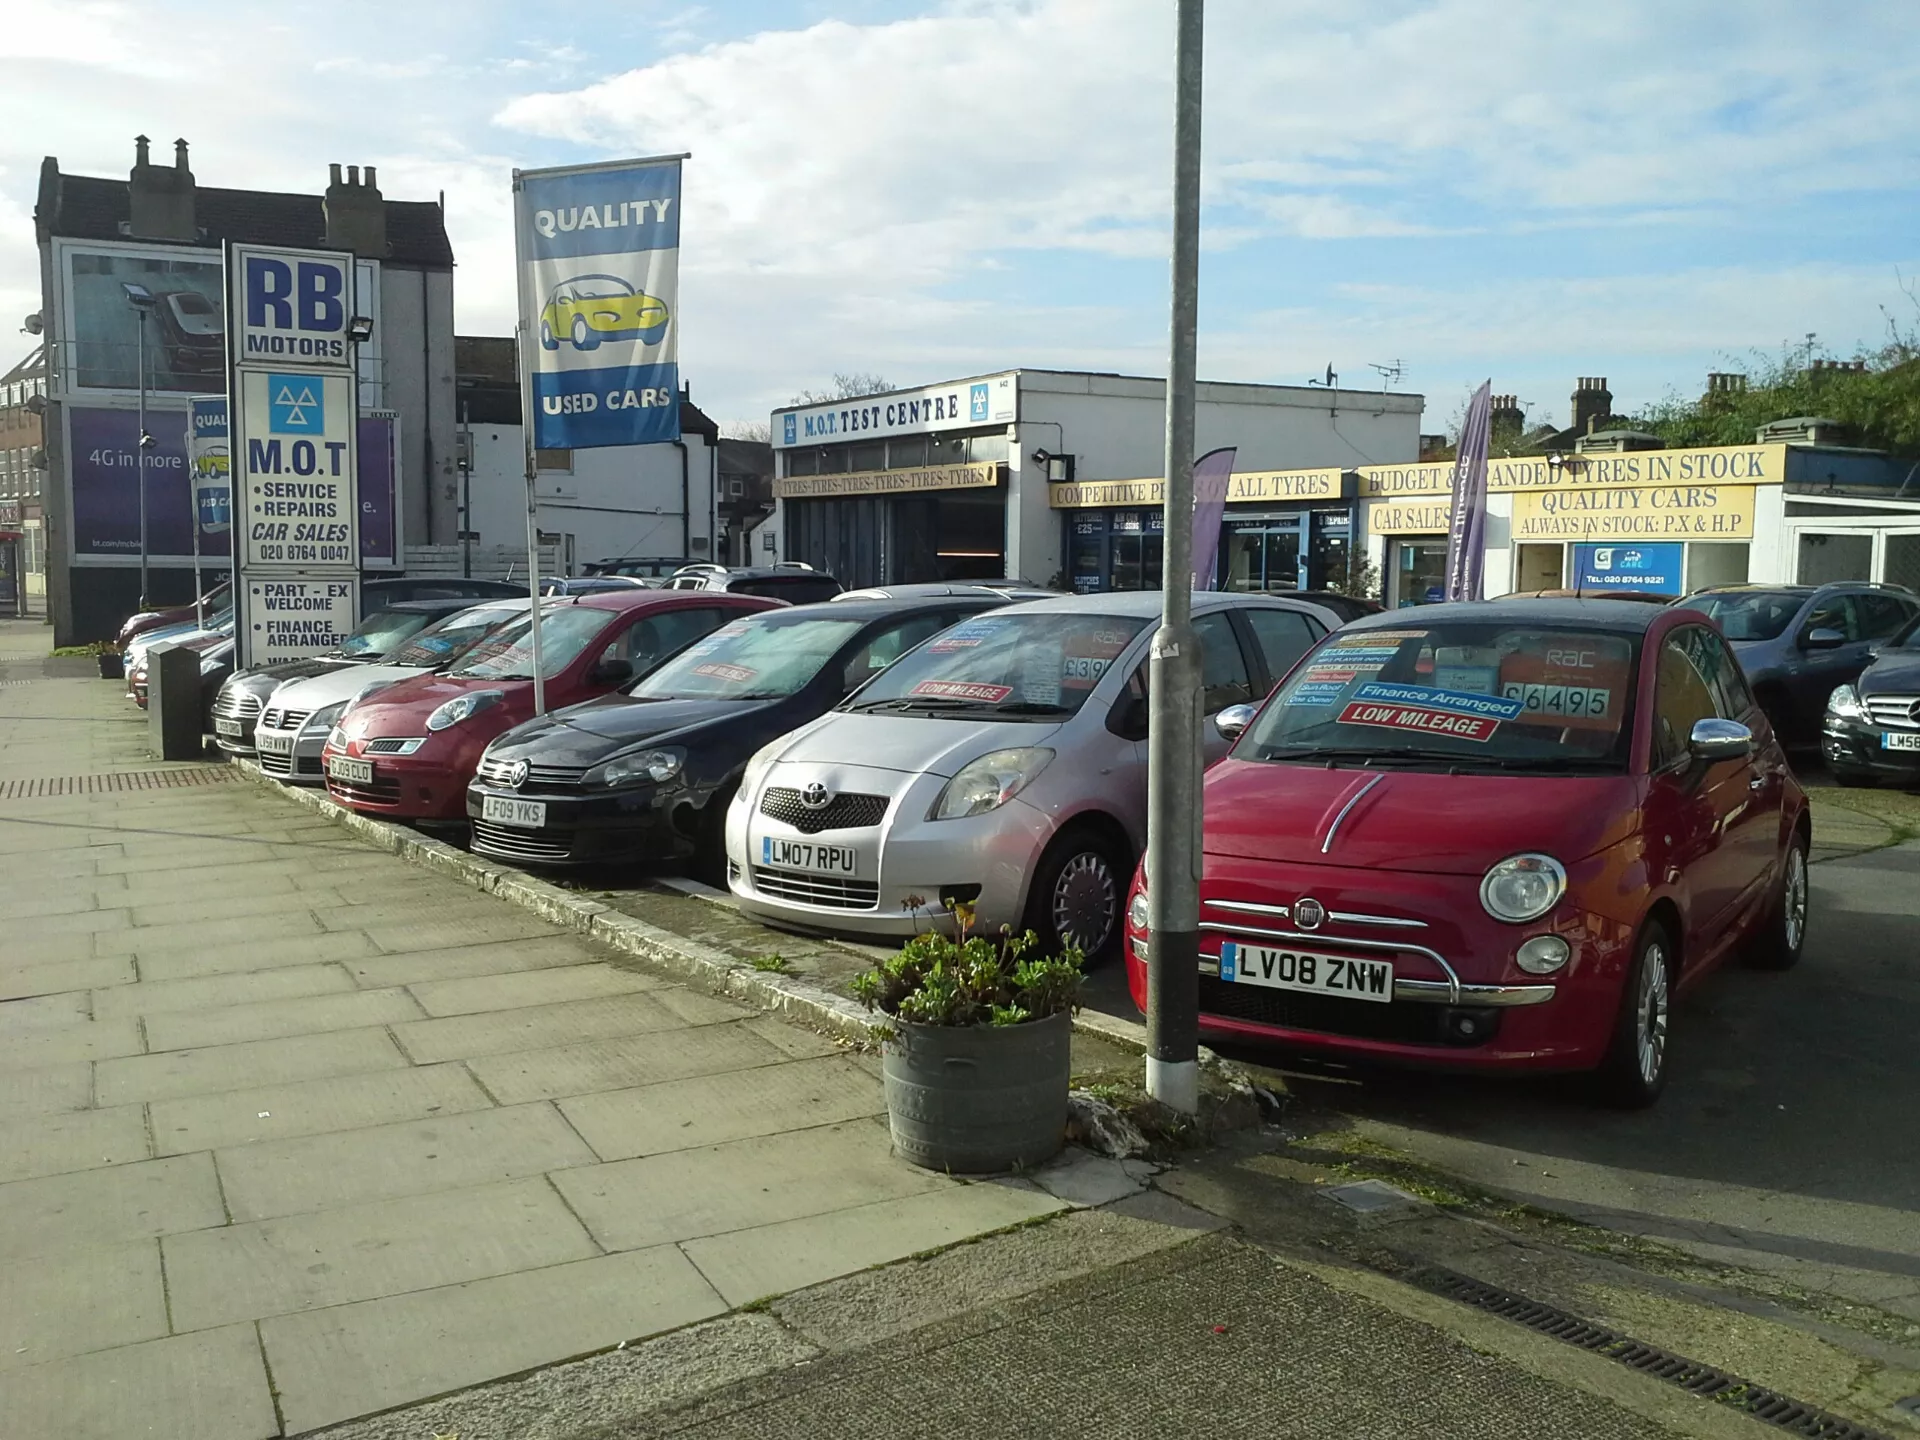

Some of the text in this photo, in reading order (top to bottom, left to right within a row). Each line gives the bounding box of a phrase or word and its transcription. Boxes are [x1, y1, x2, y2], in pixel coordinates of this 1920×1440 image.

[535, 198, 672, 238] QUALITY
[246, 257, 344, 333] RB
[247, 334, 343, 357] MOTORS
[542, 387, 670, 415] USED CARS
[196, 415, 227, 428] QUAL
[804, 394, 958, 437] M.O.T. TEST CENTRE
[89, 450, 182, 469] 4G in more
[248, 438, 347, 476] M.O.T
[1369, 467, 1441, 492] BUDGET
[1487, 462, 1562, 488] ANDED
[1569, 457, 1640, 483] TYRES
[1647, 455, 1671, 480] IN
[1679, 451, 1765, 480] STOCK
[263, 482, 337, 499] SERVICE
[1057, 484, 1146, 504] COMPETITIVE
[1234, 477, 1267, 497] ALL
[1272, 474, 1330, 496] TYRES
[219, 498, 231, 506] CA
[264, 501, 337, 518] REPAIRS
[362, 501, 377, 513] e.
[1542, 487, 1717, 514] QUALITY CARS
[1374, 508, 1402, 530] CAR
[1520, 514, 1742, 534] ALWAYS IN STOCK: P.X & H.P
[252, 523, 349, 542] CAR SALES
[260, 545, 349, 561] 020 8764 0047
[1644, 576, 1664, 584] 9221
[264, 584, 307, 597] PART
[328, 585, 348, 597] EX
[264, 597, 333, 610] WELCOME
[267, 621, 333, 633] FINANCE
[1064, 659, 1103, 678] £39
[919, 683, 1001, 699] LOW MILEAGE
[1361, 684, 1429, 701] Finance
[1430, 692, 1517, 715] Arranged
[1352, 706, 1483, 736] LOW MILEAGE
[517, 804, 540, 822] YKS
[772, 840, 853, 871] LM07 RPU
[1240, 948, 1387, 994] LV08 ZNW
